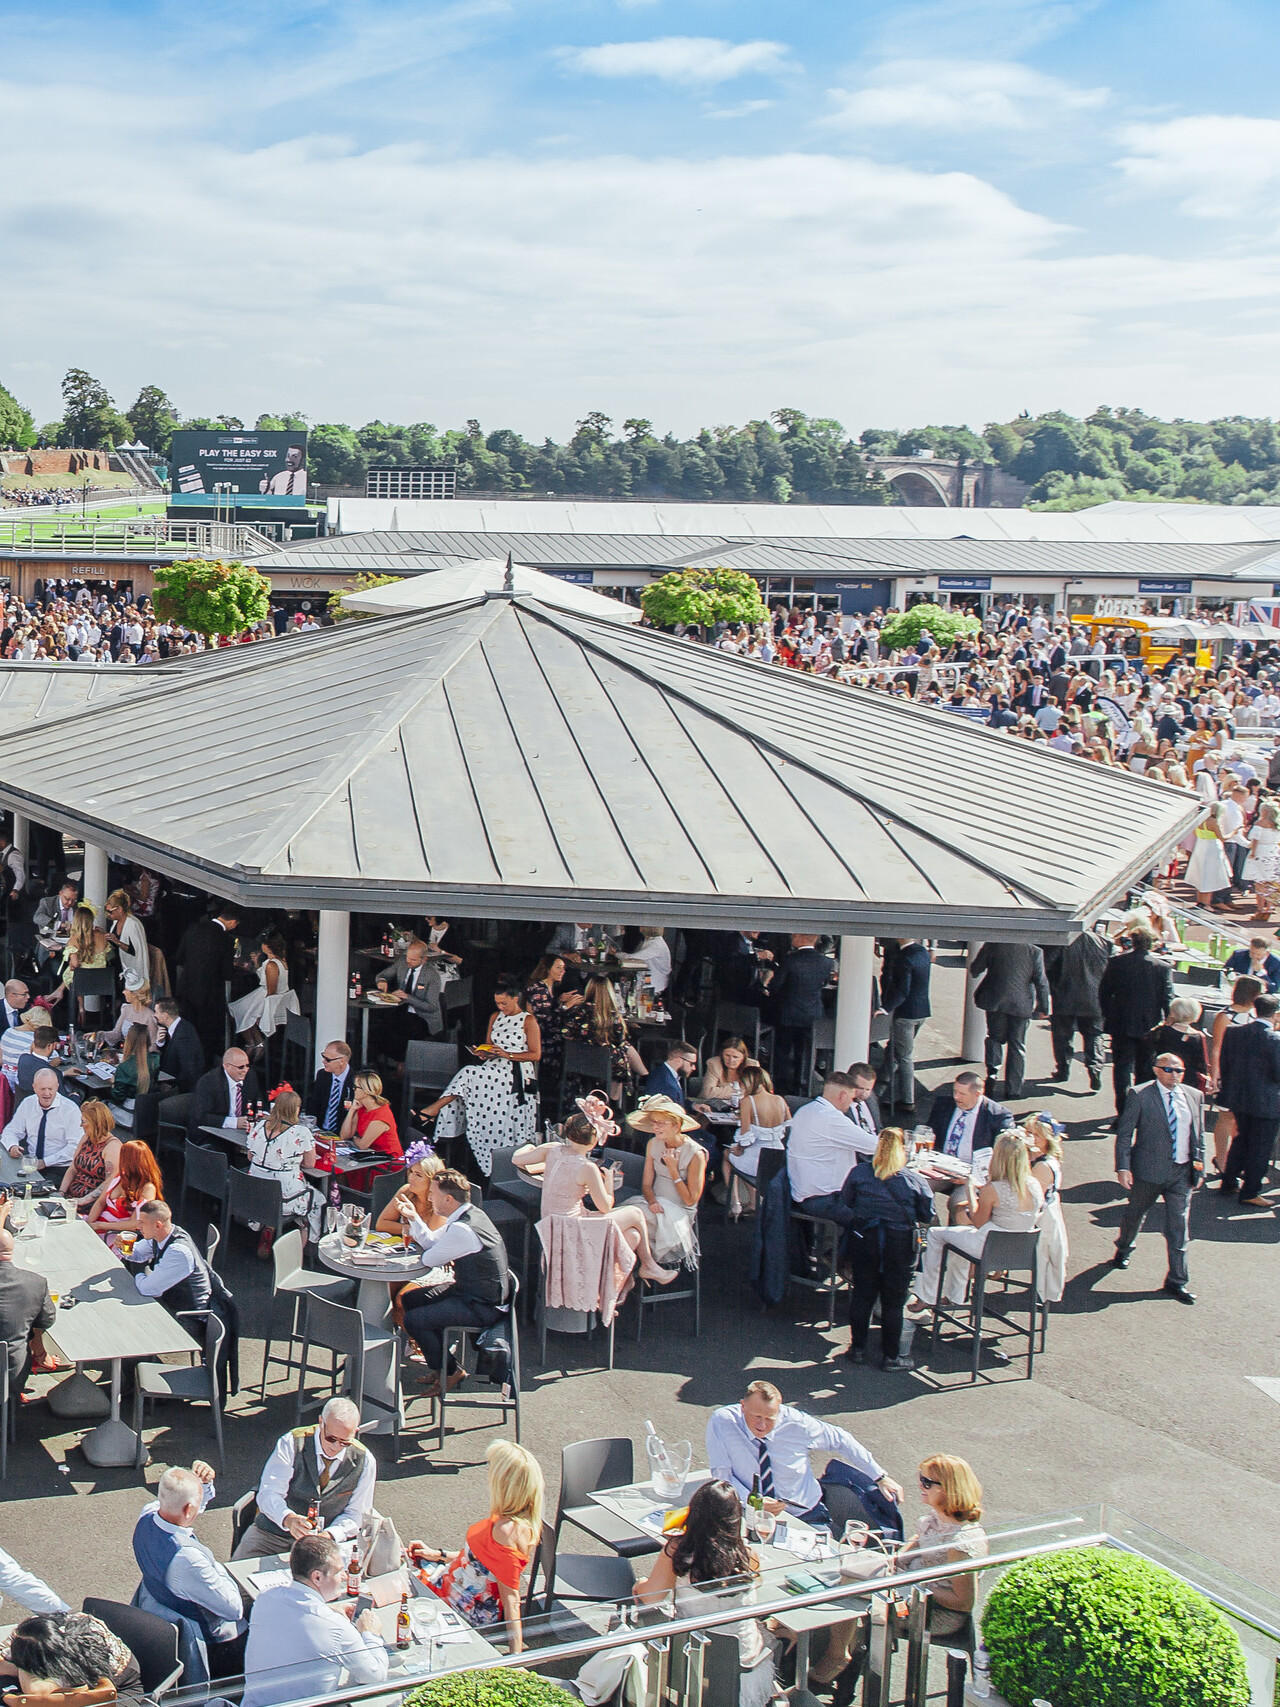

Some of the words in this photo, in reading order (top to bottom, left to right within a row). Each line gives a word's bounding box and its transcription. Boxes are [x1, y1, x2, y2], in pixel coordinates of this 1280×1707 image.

[199, 449, 220, 457] PLAY
[222, 449, 238, 457] THE
[240, 449, 261, 457] EASY
[263, 450, 278, 458] SIX
[72, 566, 105, 574] REFILL
[290, 577, 320, 588] WOK
[1094, 598, 1145, 617] COFFEE
